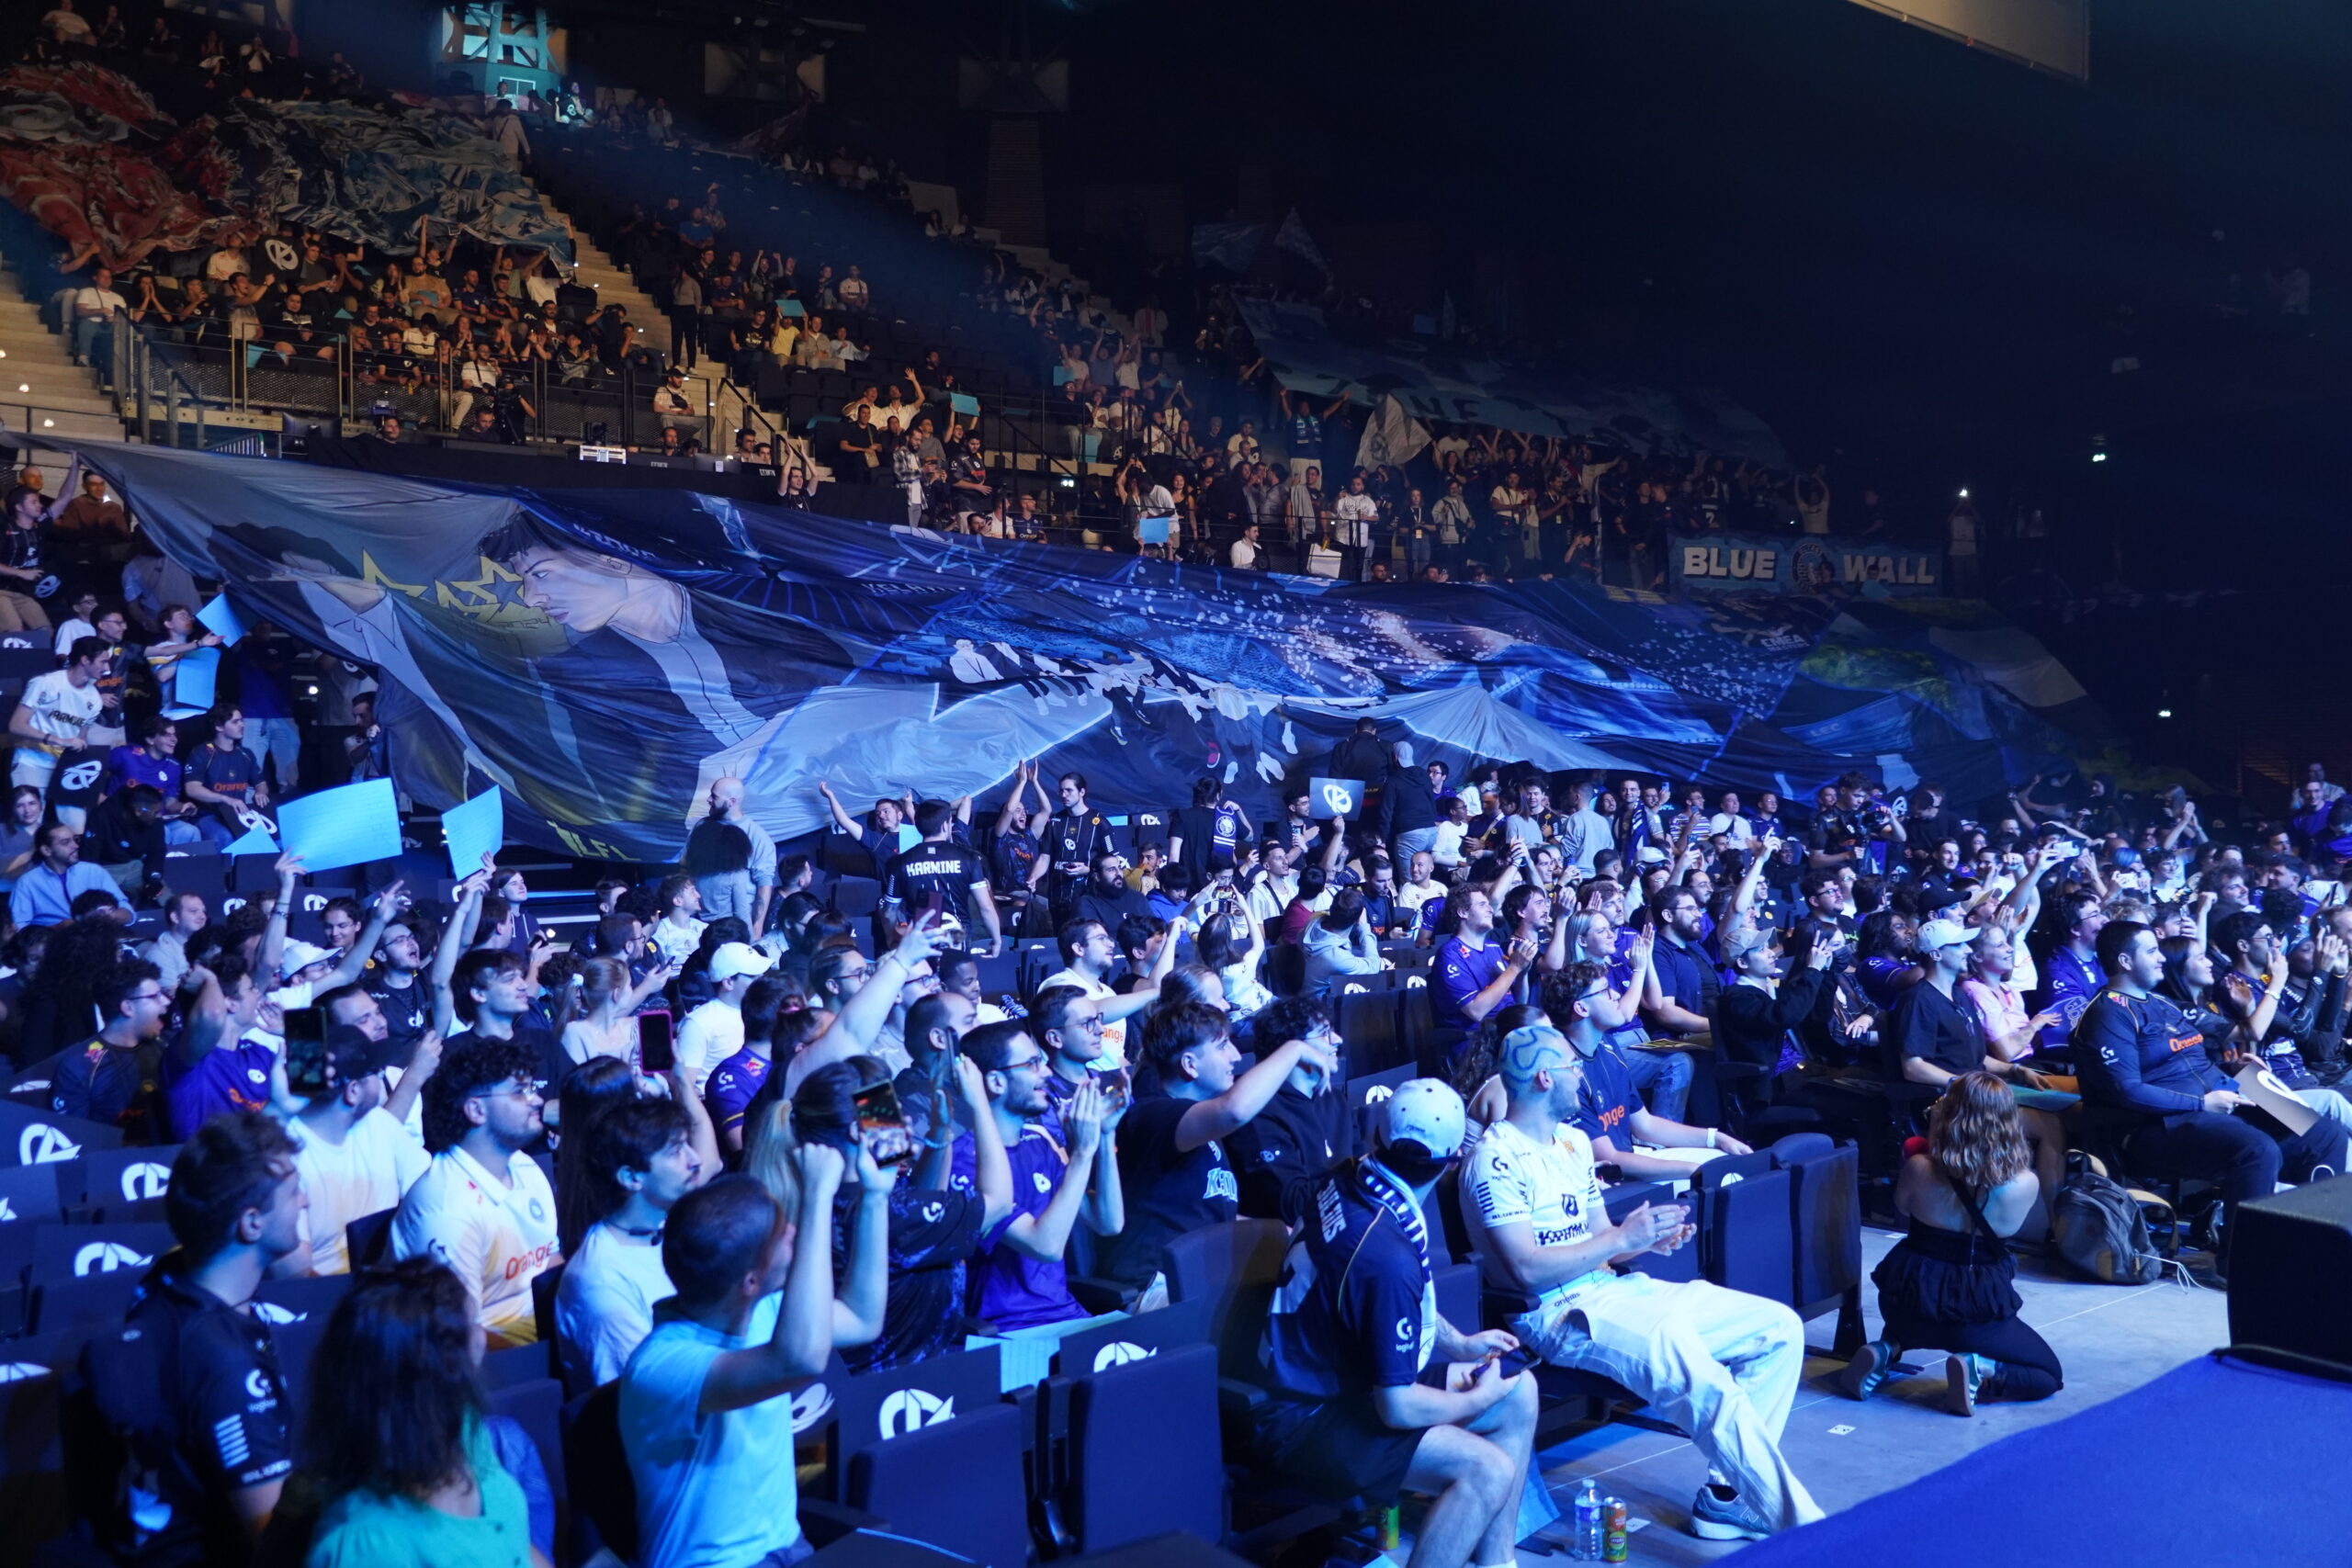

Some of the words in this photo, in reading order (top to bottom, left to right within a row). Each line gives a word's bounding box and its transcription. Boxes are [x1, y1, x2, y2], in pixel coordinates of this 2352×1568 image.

[1683, 547, 1776, 580] BLUE
[1843, 553, 1935, 584] WALL
[1810, 723, 1841, 737] LEC
[906, 860, 961, 877] KARMINE
